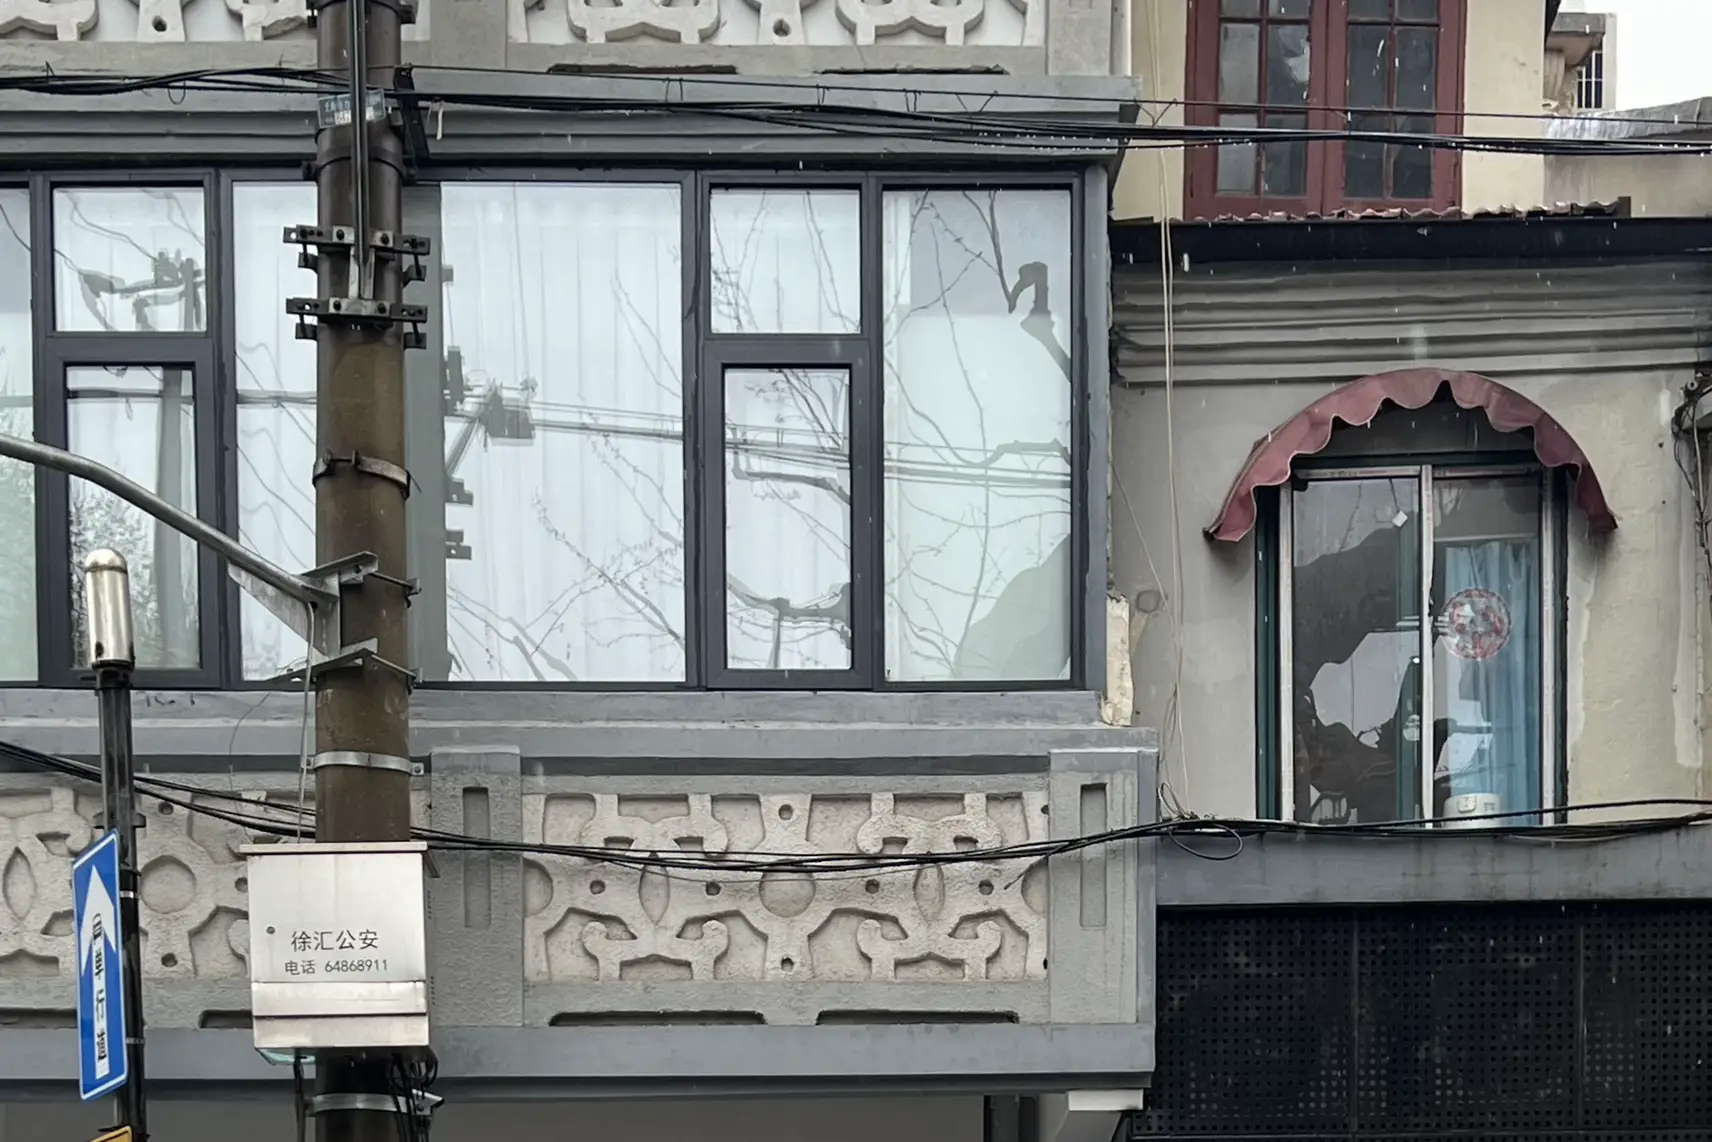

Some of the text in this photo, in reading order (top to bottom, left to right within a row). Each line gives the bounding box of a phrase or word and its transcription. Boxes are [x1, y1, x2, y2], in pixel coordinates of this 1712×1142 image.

[291, 929, 379, 952] 徐汇公安
[285, 959, 388, 976] 电话 64868911
